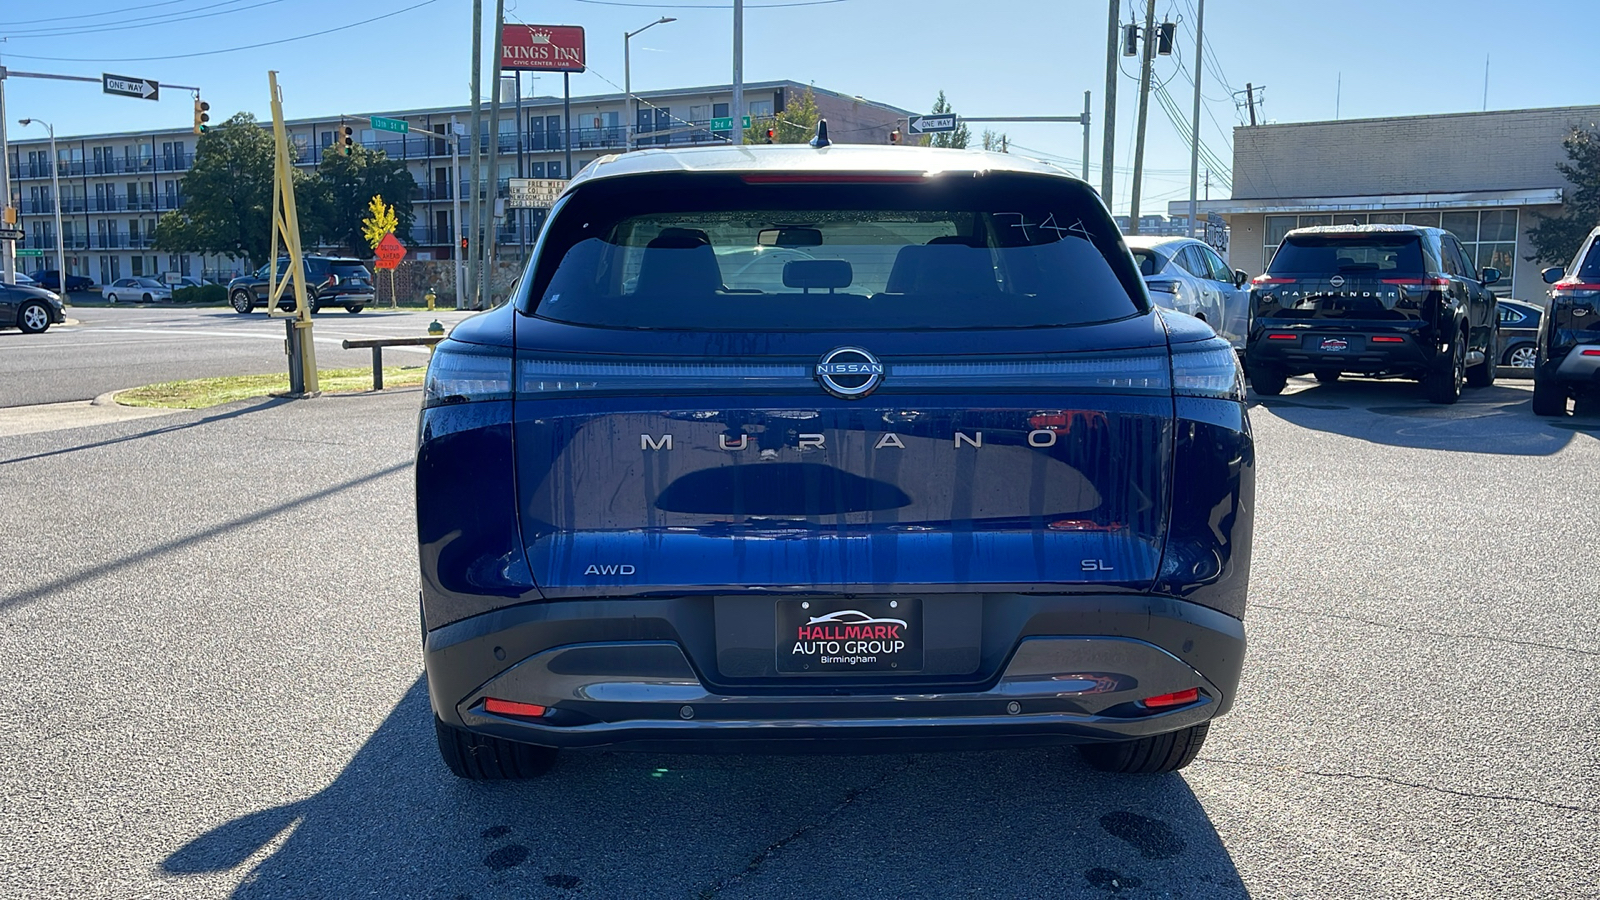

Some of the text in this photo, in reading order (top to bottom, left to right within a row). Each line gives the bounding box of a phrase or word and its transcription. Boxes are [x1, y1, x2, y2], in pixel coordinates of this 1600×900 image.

[503, 45, 580, 60] KINGS INN
[109, 80, 143, 92] ONE WAY
[714, 121, 724, 129] 3rd
[921, 119, 951, 128] ONE WAY
[818, 364, 882, 373] NISSAN
[641, 433, 1057, 450] MURANO
[584, 564, 636, 576] AWD
[1081, 559, 1114, 571] SL
[798, 625, 900, 640] HALLMARK
[792, 640, 905, 655] AUTO GROUP
[820, 655, 877, 665] Birmingham
